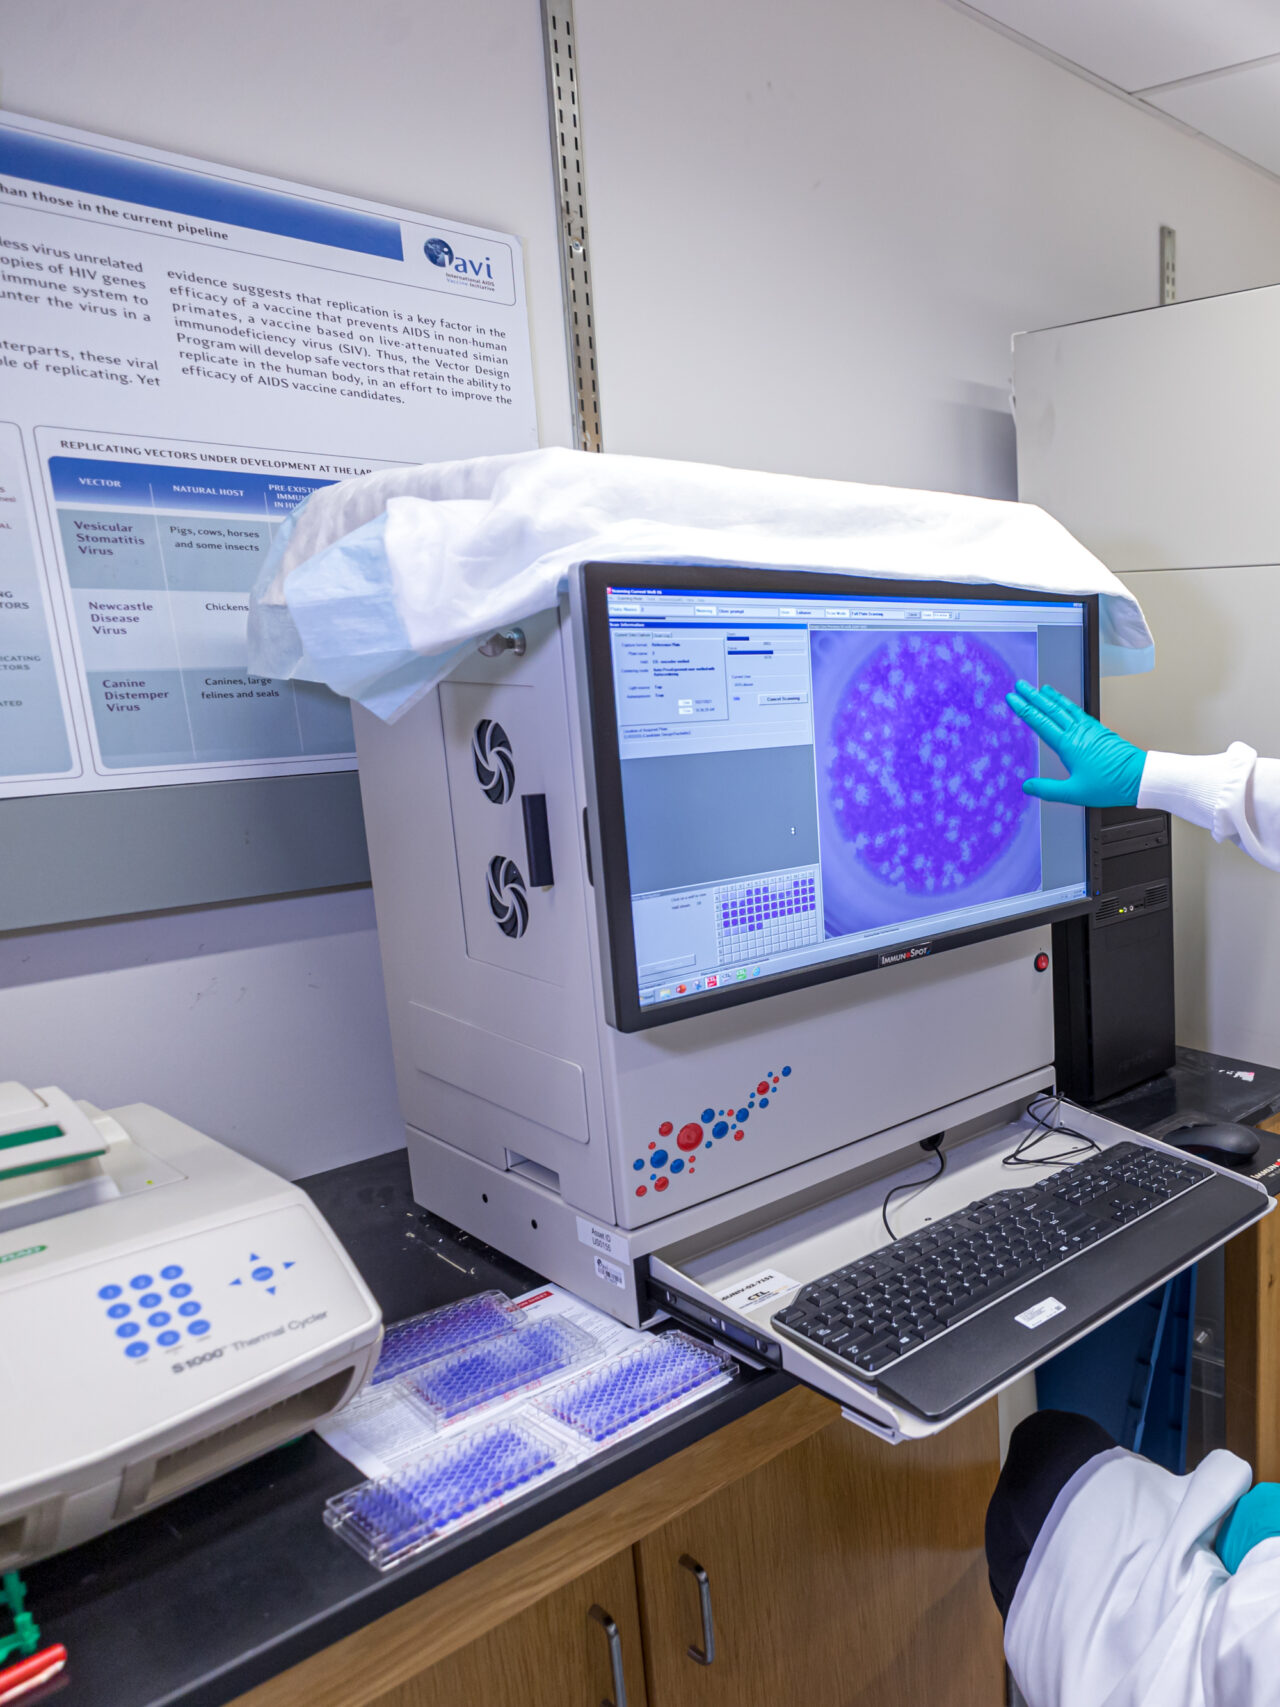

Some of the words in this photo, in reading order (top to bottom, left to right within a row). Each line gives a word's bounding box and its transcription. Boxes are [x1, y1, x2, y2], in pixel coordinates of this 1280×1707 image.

[0, 183, 27, 198] han
[32, 192, 74, 208] those
[78, 200, 92, 212] in
[96, 206, 118, 218] the
[123, 213, 172, 229] current
[178, 224, 228, 240] pipeline
[0, 236, 28, 251] less
[32, 244, 70, 259] virus
[74, 253, 143, 272] unrelated
[0, 257, 43, 272] opies
[48, 264, 64, 274] of
[69, 266, 96, 280] HIV
[102, 275, 146, 289] genes
[2, 270, 67, 290] immune
[73, 286, 128, 302] system
[133, 295, 148, 306] to
[47, 296, 73, 309] the
[79, 304, 117, 317] virus
[124, 309, 137, 320] in
[143, 314, 151, 322] a
[167, 270, 227, 288] evidence
[232, 282, 292, 300] suggests
[296, 293, 322, 305] that
[327, 299, 389, 318] replication
[394, 311, 403, 320] is
[417, 314, 436, 328] key
[440, 318, 472, 332] factor
[476, 324, 485, 335] in
[490, 328, 506, 338] the
[170, 286, 228, 306] efficacy
[233, 297, 246, 306] of
[264, 304, 312, 318] vaccine
[316, 312, 341, 323] that
[347, 318, 398, 333] prevents
[403, 326, 430, 338] AIDS
[434, 331, 444, 341] in
[448, 336, 507, 352] non-human
[172, 303, 242, 323] primates,
[261, 318, 310, 332] vaccine
[317, 325, 353, 340] based
[360, 335, 374, 343] on
[380, 336, 468, 358] live-attenuated
[473, 353, 508, 365] simian
[0, 340, 74, 360] terparts,
[80, 350, 121, 365] these
[126, 358, 158, 371] viral
[175, 318, 296, 347] immunodeficiency
[302, 339, 332, 350] virus
[339, 344, 370, 358] (SIV).
[376, 349, 406, 364] Thus,
[412, 356, 430, 366] the
[435, 359, 469, 372] Vector
[475, 365, 509, 380] Design
[177, 332, 236, 350] Program
[239, 343, 261, 354] will
[264, 347, 312, 364] develop
[315, 356, 340, 368] safe
[343, 360, 385, 373] vectors
[388, 366, 410, 376] that
[414, 371, 444, 382] retain
[447, 375, 464, 384] the
[467, 378, 498, 391] ability
[501, 382, 511, 391] to
[23, 360, 39, 370] of
[45, 364, 132, 385] replicating.
[137, 374, 160, 387] Yet
[180, 351, 238, 366] replicate
[244, 359, 255, 368] in
[261, 361, 281, 372] the
[286, 364, 327, 378] human
[332, 371, 363, 386] body,
[368, 377, 378, 387] in
[400, 381, 432, 394] effort
[436, 387, 447, 396] to
[452, 390, 492, 403] improve
[496, 395, 512, 405] the
[182, 365, 236, 383] efficacy
[240, 374, 253, 383] of
[258, 376, 289, 388] AIDS
[292, 382, 337, 395] vaccine
[340, 389, 404, 404] candidates.
[60, 440, 141, 455] REPLICATING
[144, 448, 197, 460] VECTORS
[200, 454, 237, 464] UNDER
[240, 458, 316, 470] DEVELOPMENT
[333, 467, 351, 475] THE
[78, 477, 121, 487] VECTOR
[173, 485, 217, 495] NATURAL
[220, 488, 244, 497] HOST
[73, 520, 133, 532] Vesicular
[170, 526, 196, 536] Pigs,
[198, 529, 225, 538] cows,
[228, 529, 260, 538] horses
[76, 533, 145, 545] Stomatitis
[175, 540, 193, 549] and
[225, 542, 260, 551] insects
[78, 546, 113, 556] Virus
[88, 602, 153, 611] Newcastle
[205, 603, 249, 612] Chickens
[91, 613, 140, 622] Disease
[92, 626, 127, 635] Virus
[102, 679, 146, 688] Canine
[205, 676, 245, 686] Canines,
[248, 676, 272, 686] large
[105, 691, 169, 701] Distemper
[201, 690, 234, 700] felines
[236, 690, 251, 699] and
[253, 689, 280, 698] seals
[106, 703, 140, 712] Virus
[232, 1325, 285, 1351] Thermal
[288, 1311, 328, 1331] Cycler
